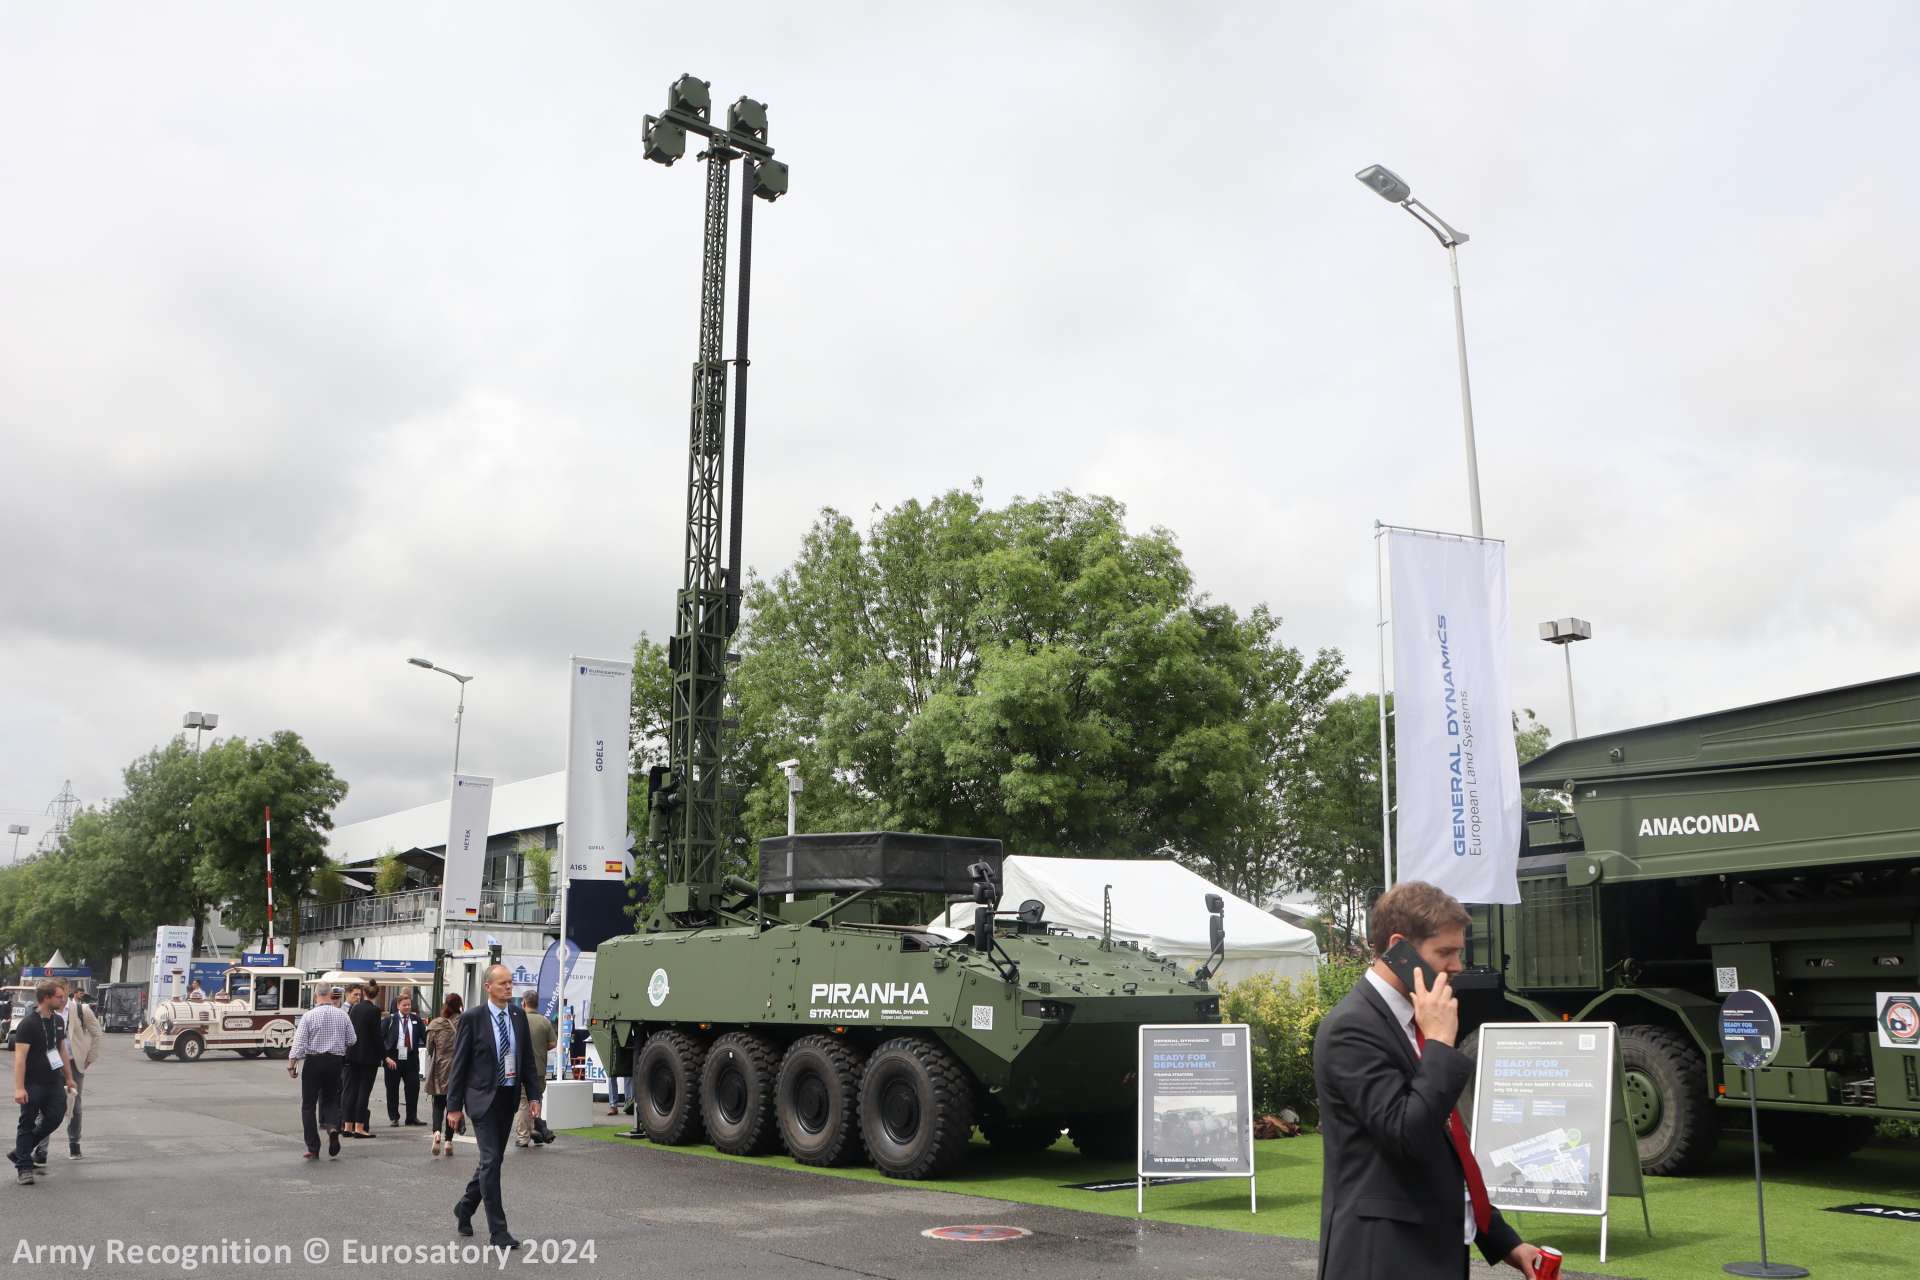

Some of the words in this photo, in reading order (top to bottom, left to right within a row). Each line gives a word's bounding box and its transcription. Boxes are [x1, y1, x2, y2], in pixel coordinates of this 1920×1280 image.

[1437, 614, 1459, 736] DYNAMICS
[1460, 688, 1474, 748] Systems
[595, 739, 604, 772] GDELS
[1464, 752, 1477, 785] Land
[1449, 743, 1466, 857] GENERAL
[1469, 790, 1482, 856] European
[1638, 812, 1761, 837] ANACONDA
[512, 969, 538, 983] ETEK
[810, 982, 930, 1005] PIRANHA
[808, 1008, 870, 1019] STRATCOM
[1153, 1061, 1216, 1069] DEPLOYMENT
[1494, 1068, 1569, 1077] DEPLOYMENT
[1495, 1059, 1532, 1068] READY
[1535, 1060, 1560, 1068] FOR
